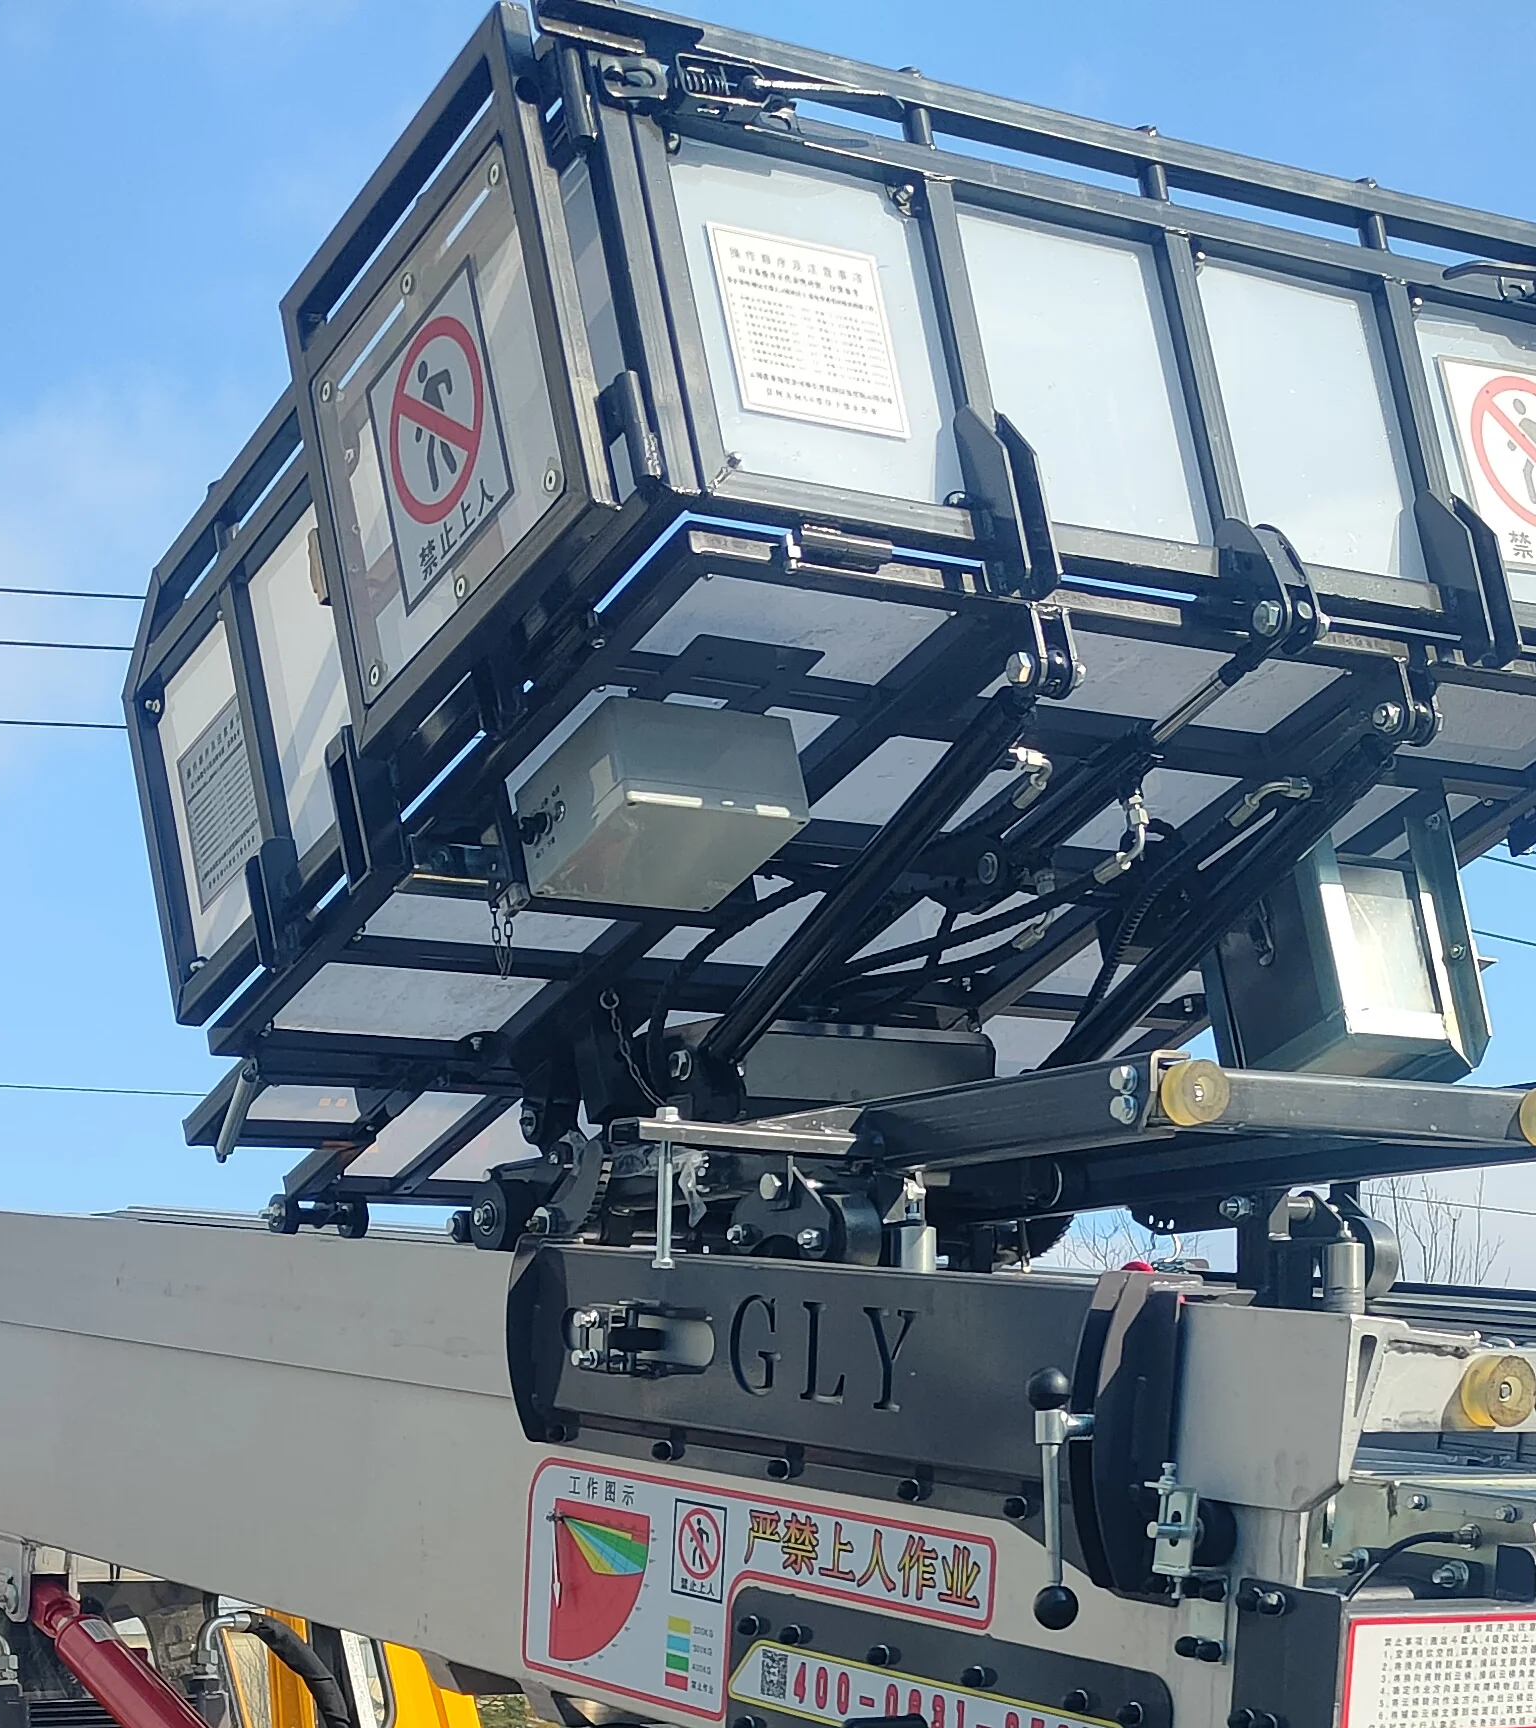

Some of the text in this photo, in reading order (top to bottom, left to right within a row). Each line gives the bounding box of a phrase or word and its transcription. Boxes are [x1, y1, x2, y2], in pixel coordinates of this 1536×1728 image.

[419, 478, 494, 581] 禁止上人
[729, 1294, 920, 1413] GLY
[568, 1475, 635, 1506] 工作图示
[680, 1577, 715, 1597] 禁止上人
[743, 1508, 981, 1609] 严禁上人作业
